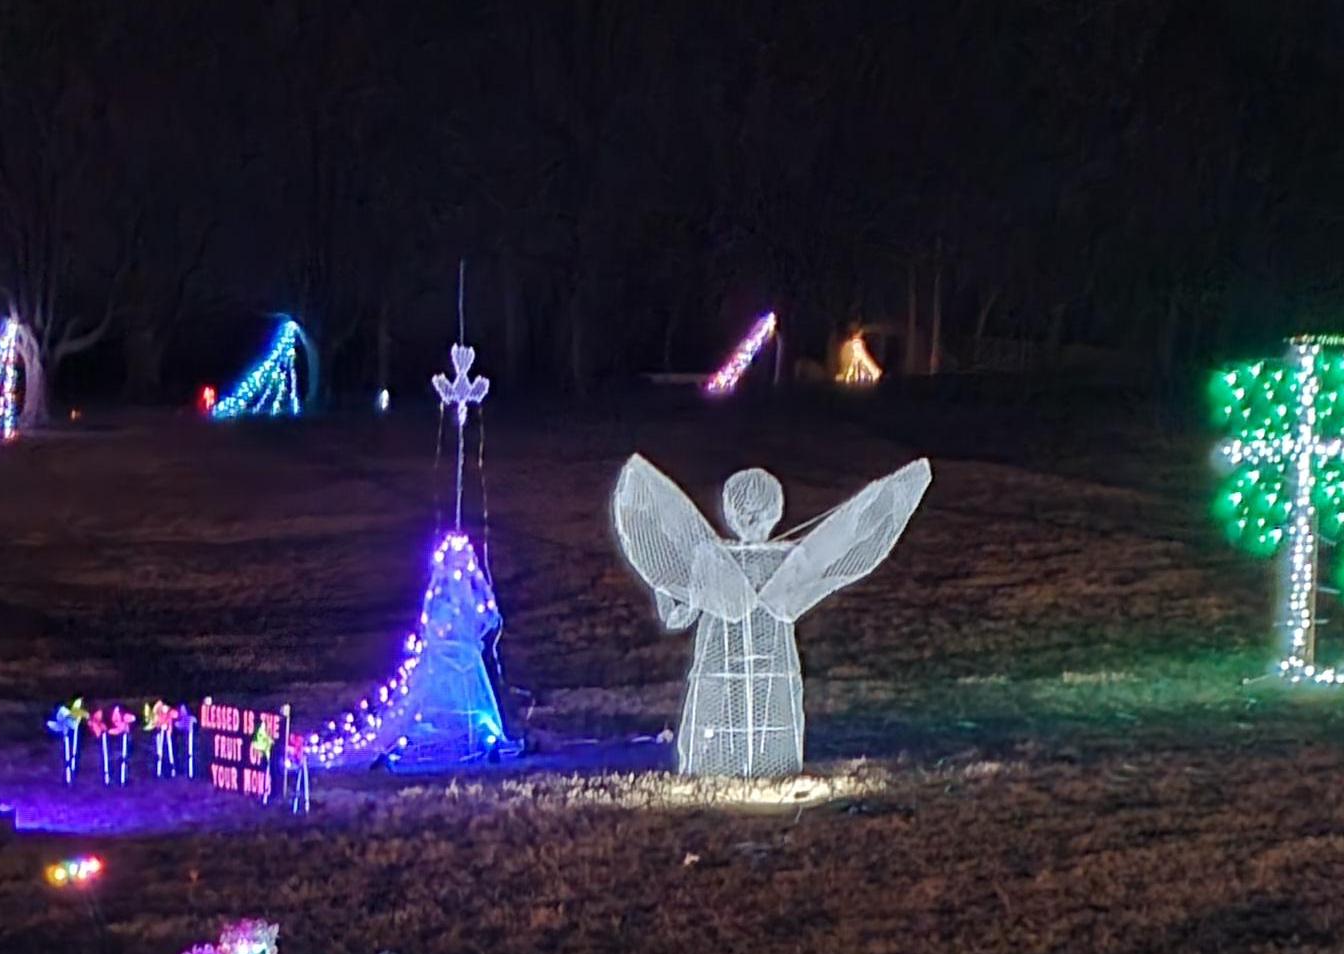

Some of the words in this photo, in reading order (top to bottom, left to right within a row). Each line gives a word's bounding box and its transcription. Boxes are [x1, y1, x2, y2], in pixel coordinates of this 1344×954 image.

[242, 710, 255, 736] IS
[214, 733, 244, 762] FRUIT
[211, 763, 238, 791] YOUR
